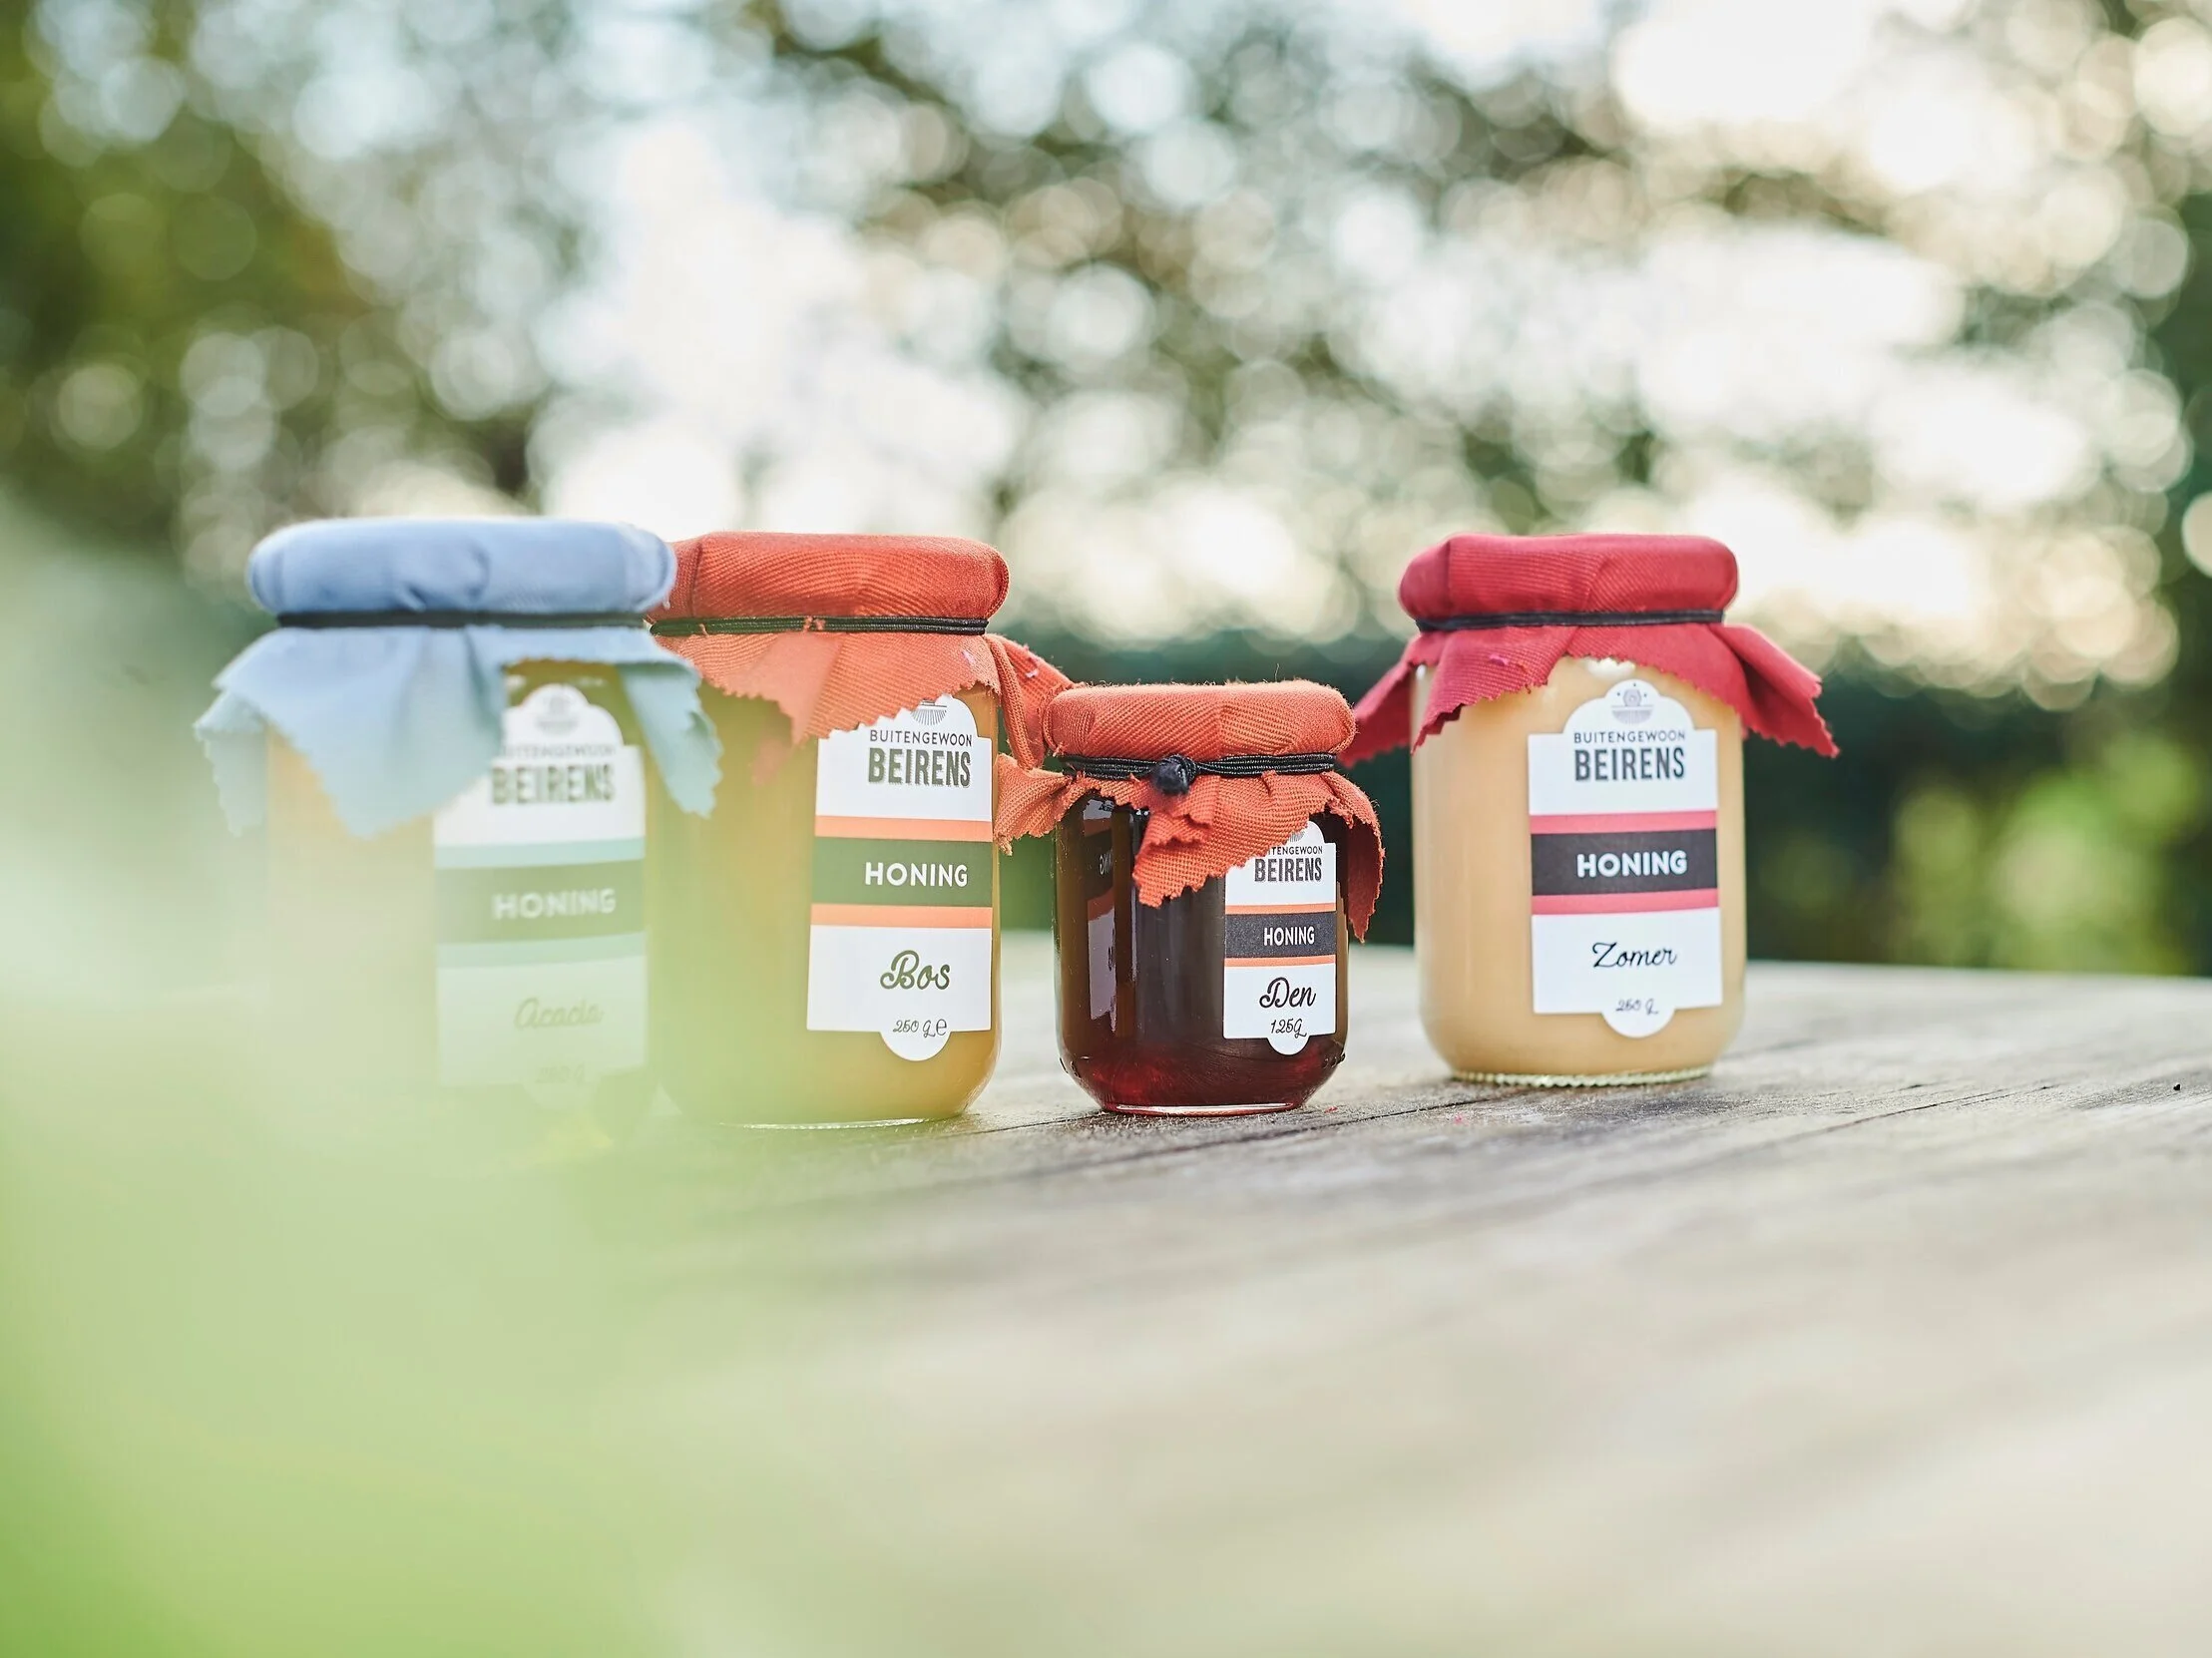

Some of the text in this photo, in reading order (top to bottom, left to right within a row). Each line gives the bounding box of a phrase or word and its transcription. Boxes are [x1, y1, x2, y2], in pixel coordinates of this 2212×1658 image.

[870, 729, 973, 747] BUITENGEWOON
[1573, 729, 1686, 744] BUITENGEWOON
[868, 747, 971, 788] BEIRENS
[1574, 746, 1685, 781] BEIRENS
[492, 764, 615, 805] BEIRENS
[864, 861, 968, 888] HONING
[1254, 857, 1323, 882] BEIRENS
[1576, 850, 1688, 878] HONING
[492, 889, 616, 920] HONING
[1263, 926, 1315, 947] HONING
[1591, 941, 1678, 969] Zomer
[879, 950, 951, 990] Bos
[1259, 977, 1317, 1009] Den
[893, 1020, 919, 1033] 250
